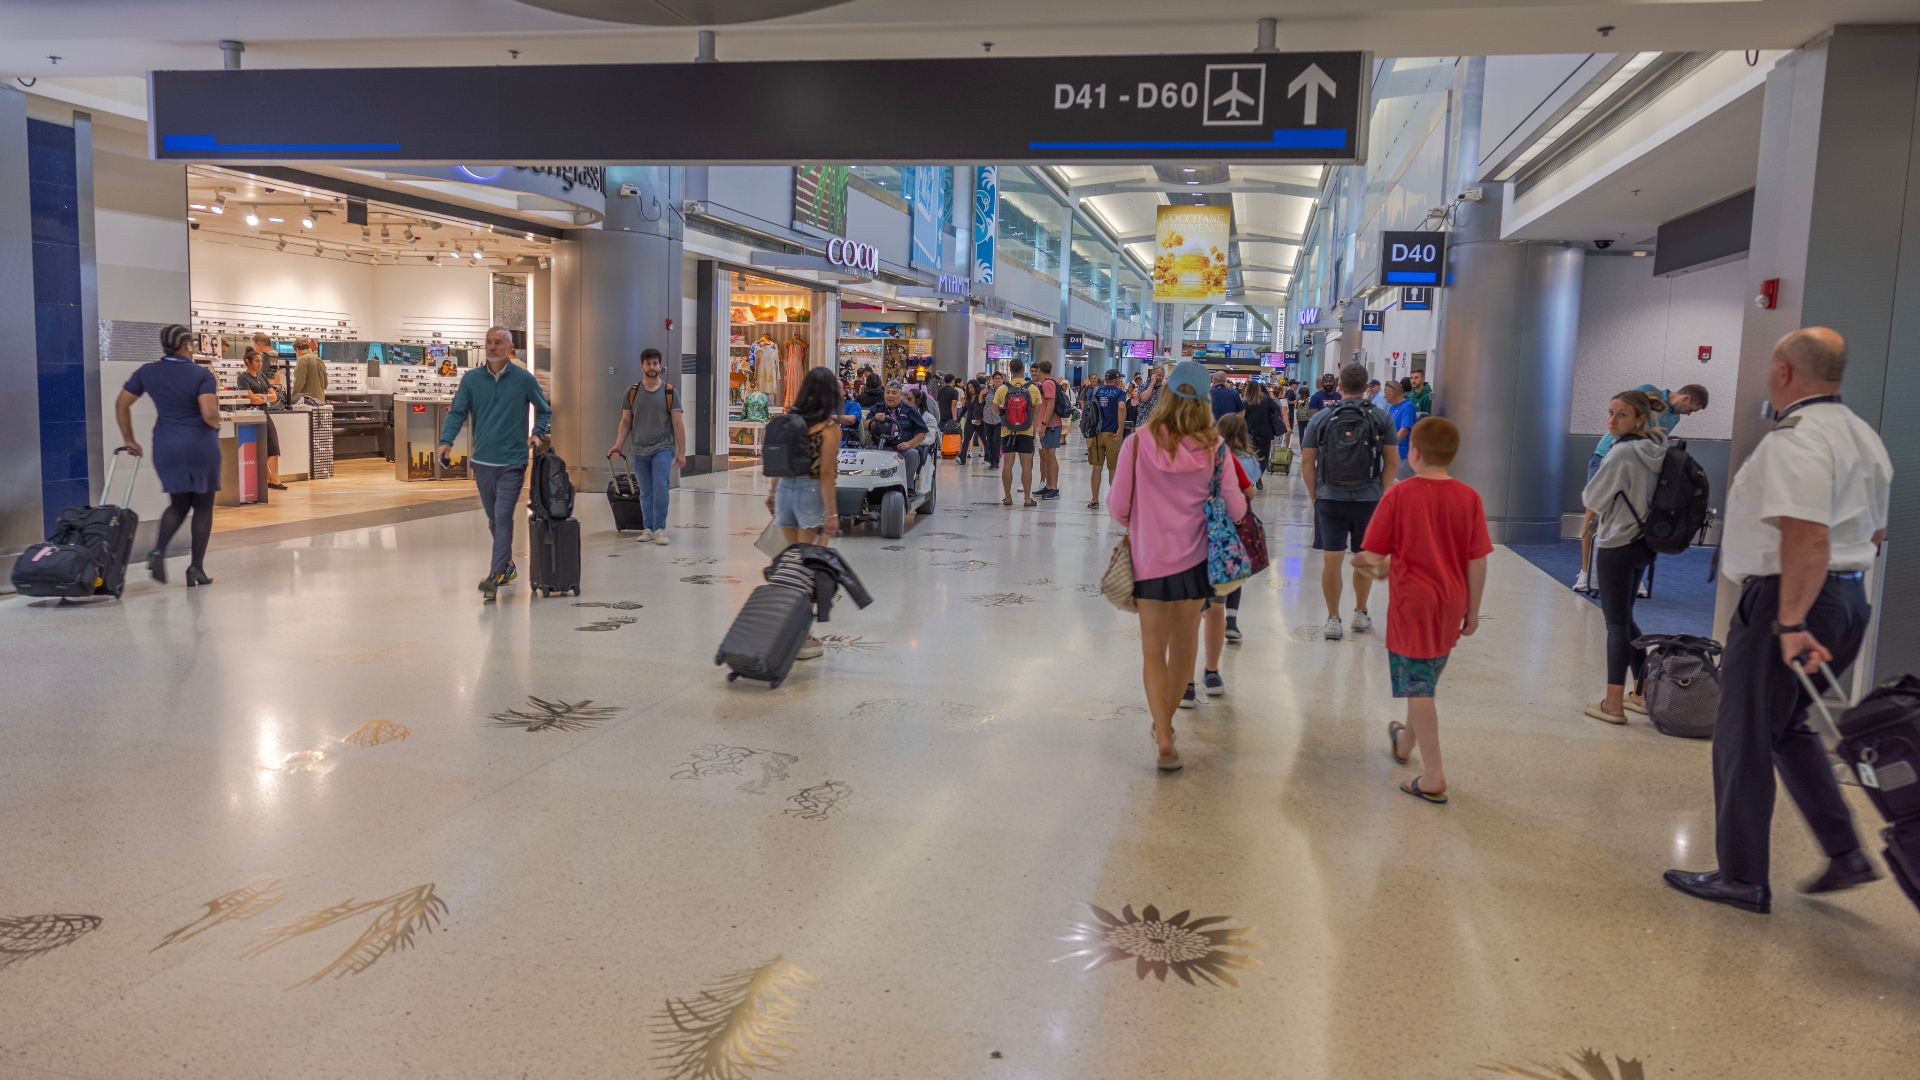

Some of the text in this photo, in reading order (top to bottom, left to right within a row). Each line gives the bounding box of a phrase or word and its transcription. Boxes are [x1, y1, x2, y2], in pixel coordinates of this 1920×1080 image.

[1054, 83, 1107, 109] D41
[1137, 82, 1199, 108] D60
[1162, 213, 1225, 224] L'OCCITANE
[1170, 223, 1227, 233] PROVENCE
[1391, 243, 1436, 263] D40
